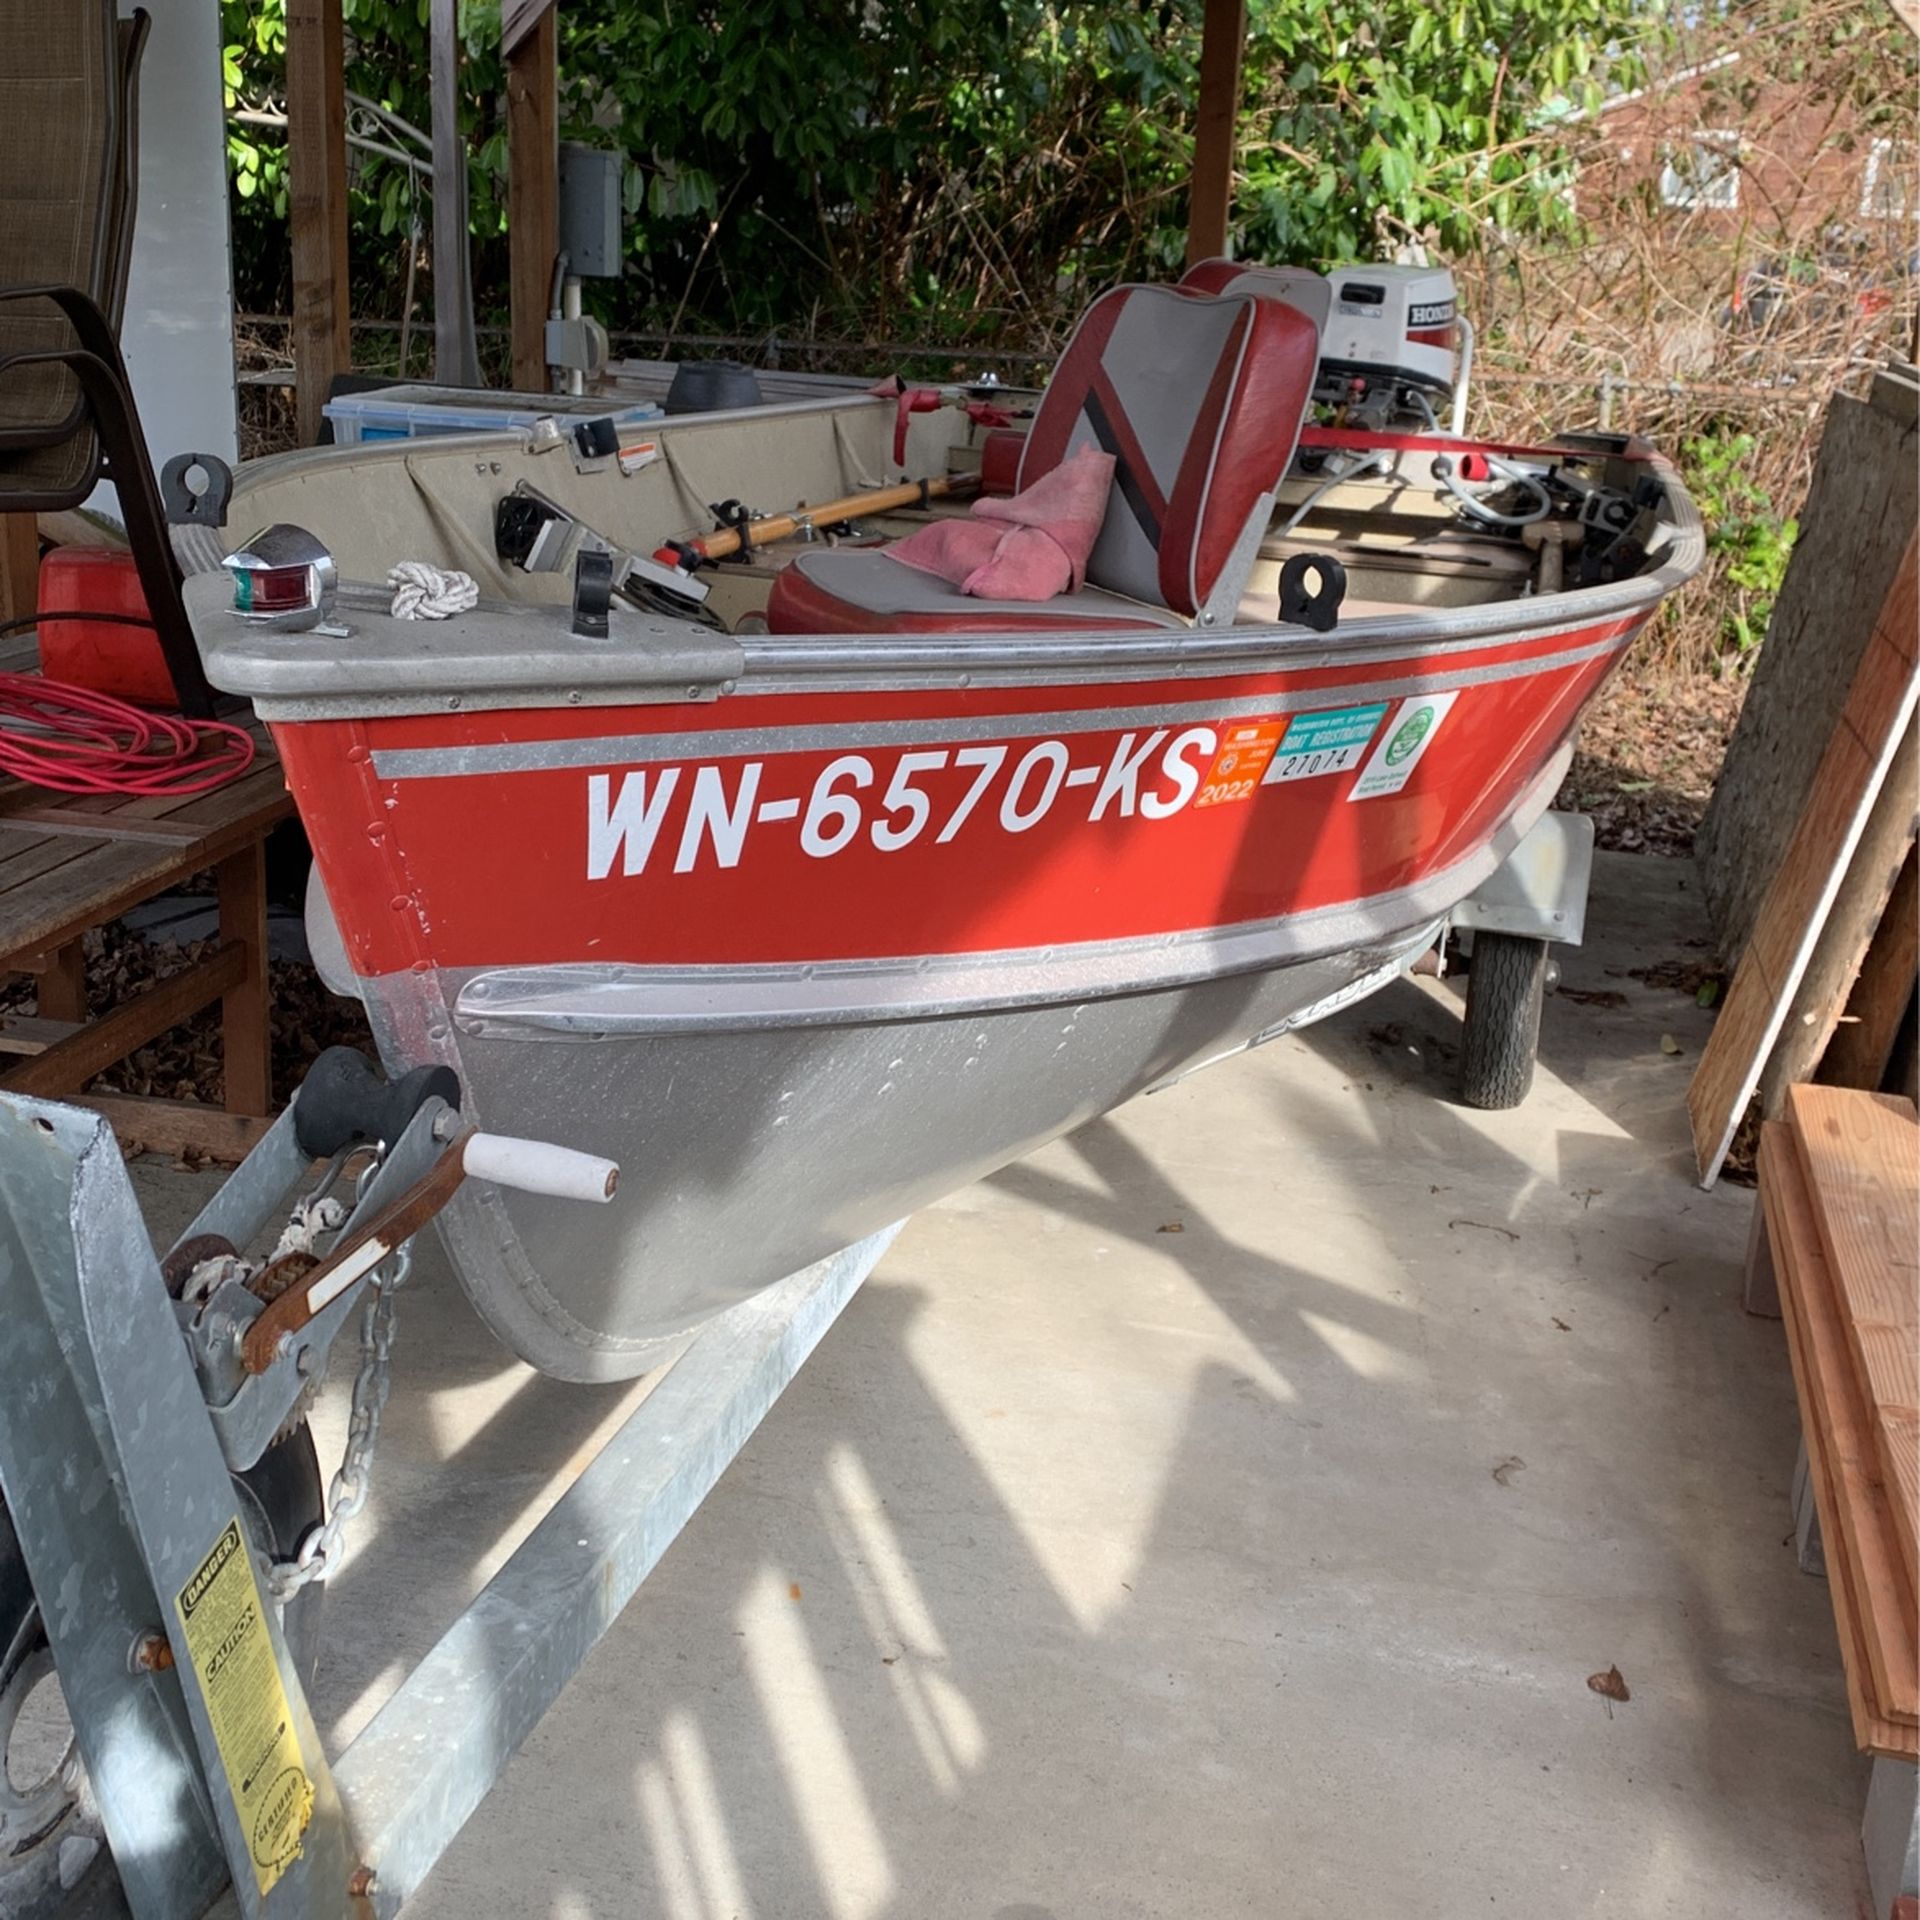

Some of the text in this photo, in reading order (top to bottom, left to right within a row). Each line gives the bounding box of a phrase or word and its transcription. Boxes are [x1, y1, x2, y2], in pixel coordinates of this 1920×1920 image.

[587, 727, 1217, 881] WN-6570-KS
[1196, 778, 1255, 806] 2022
[186, 1536, 235, 1605] DANGER
[207, 1602, 257, 1681] CAUTION
